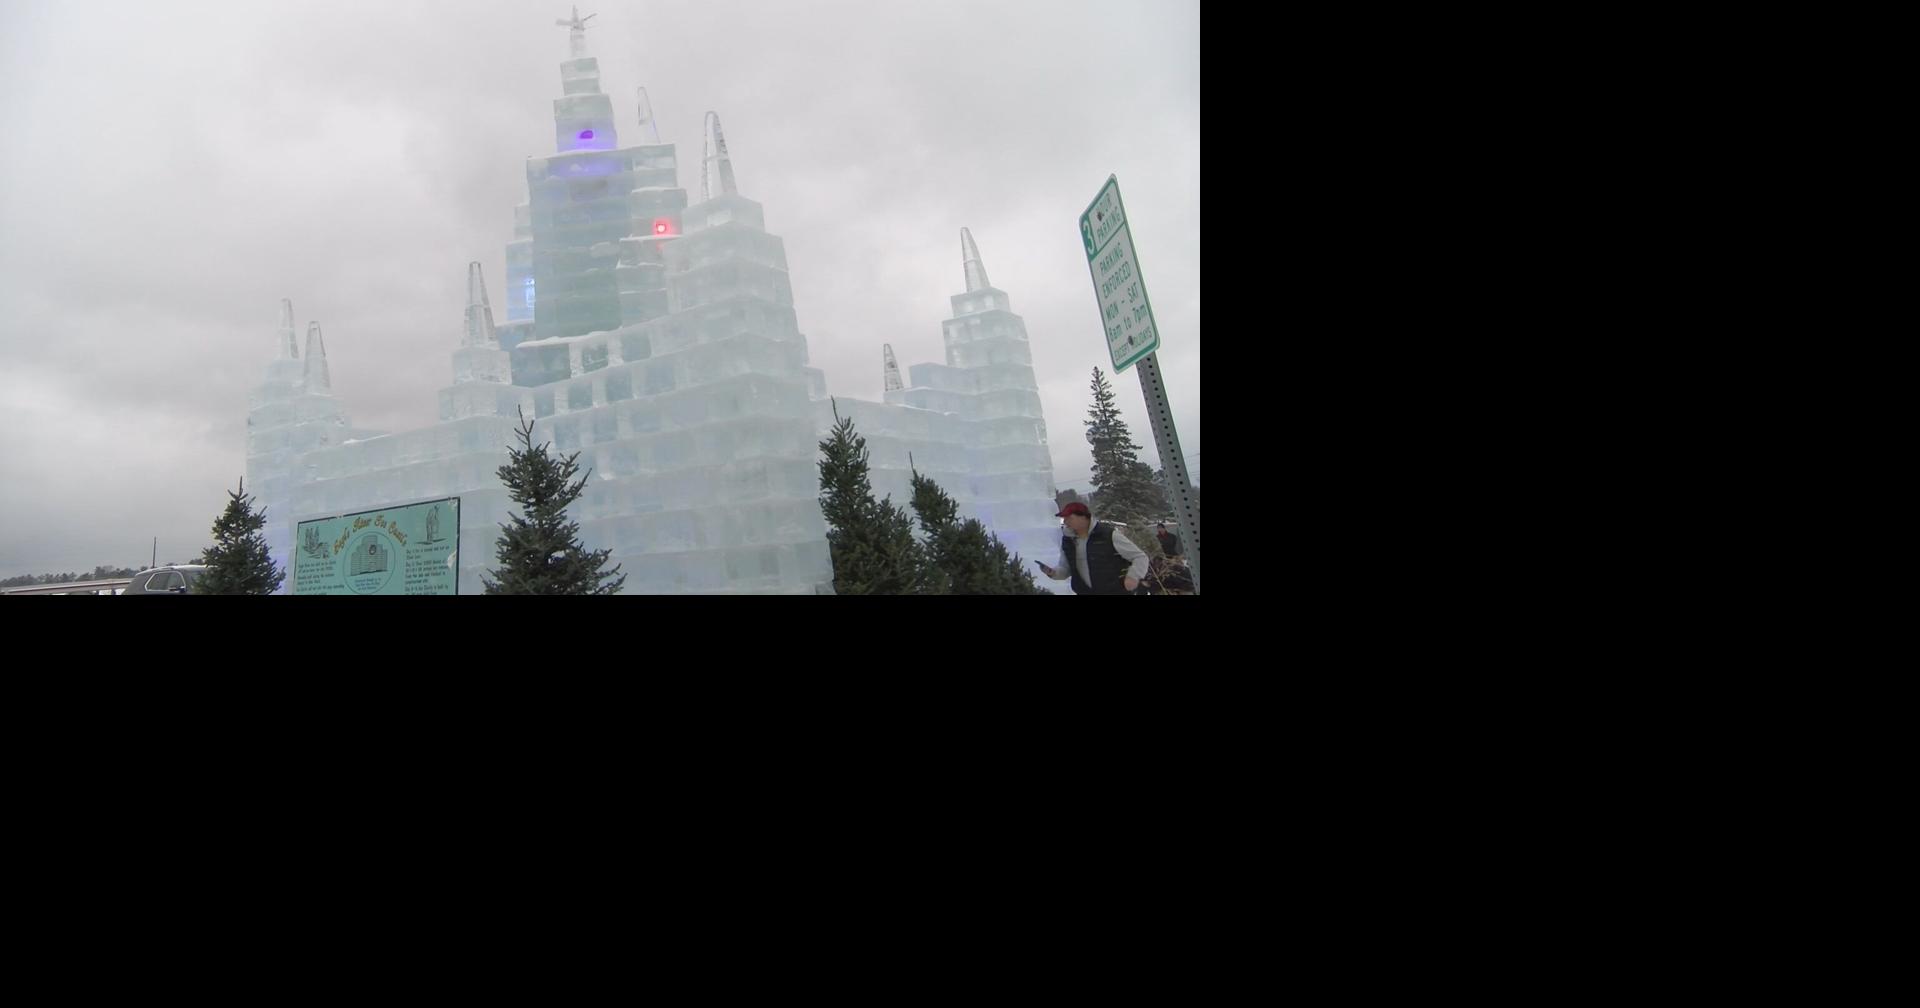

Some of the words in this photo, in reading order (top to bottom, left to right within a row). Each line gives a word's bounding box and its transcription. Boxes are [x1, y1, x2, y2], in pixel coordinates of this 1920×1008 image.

[1096, 192, 1112, 221] OUR
[1097, 206, 1121, 240] PARKING
[1083, 219, 1095, 255] 3
[1100, 242, 1123, 273] PARKING
[1102, 261, 1131, 298] ENFORCED
[1106, 301, 1119, 320] MON
[1128, 282, 1139, 303] SAT
[1124, 314, 1132, 330] to
[1132, 303, 1147, 325] 7pm
[1114, 342, 1130, 360] EXCEPT
[1130, 326, 1152, 349] OLIDAYS
